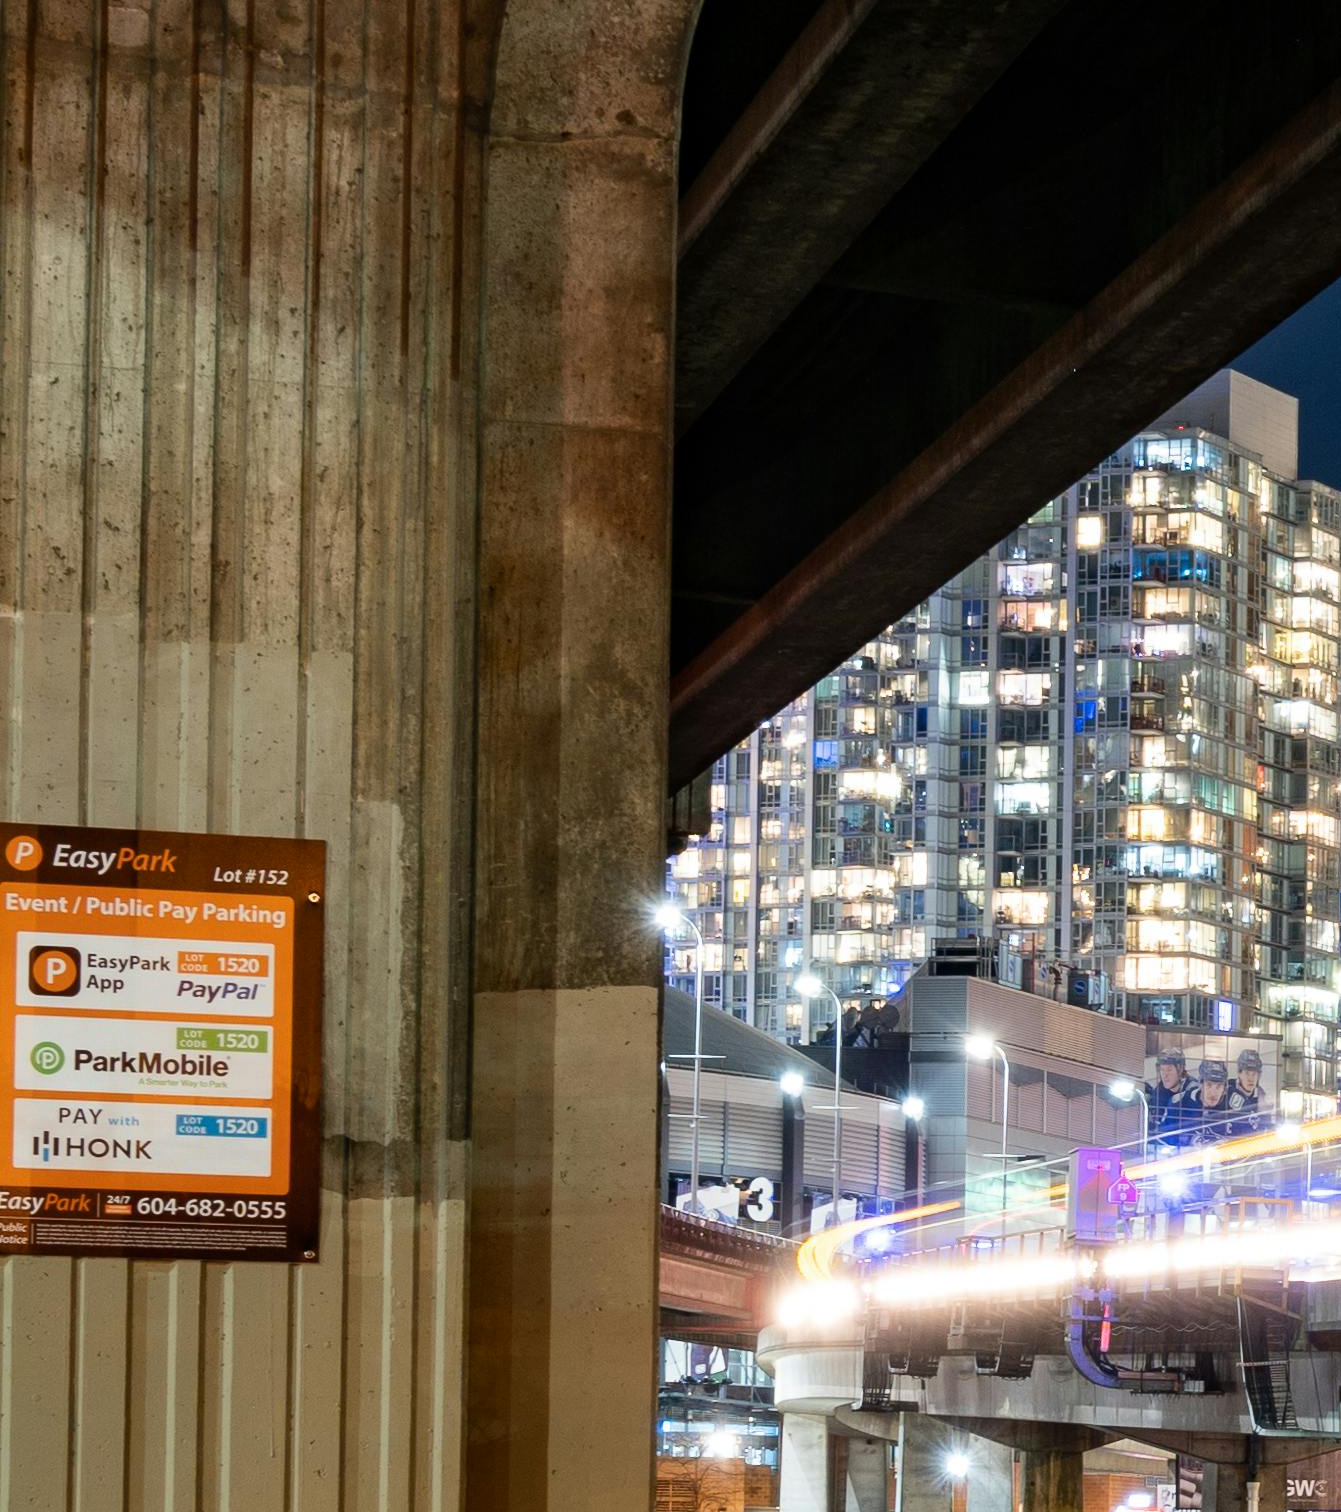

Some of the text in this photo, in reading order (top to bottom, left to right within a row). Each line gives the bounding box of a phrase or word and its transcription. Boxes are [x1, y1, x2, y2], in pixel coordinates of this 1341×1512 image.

[52, 843, 178, 875] EasyPark
[213, 866, 289, 885] Lot #152
[5, 892, 68, 913] Event
[86, 896, 154, 918] Public
[158, 900, 198, 924] Pay
[202, 902, 286, 929] Parking
[87, 953, 171, 973] EasyPark
[185, 953, 205, 962] LOT
[217, 957, 260, 973] 1520
[180, 963, 209, 973] CODE
[86, 974, 124, 993] App
[176, 980, 258, 1003] PayPal
[179, 1039, 208, 1048] CODE
[183, 1030, 203, 1038] LOT
[216, 1033, 259, 1049] 1520
[74, 1049, 229, 1077] ParkMobile
[59, 1107, 140, 1126] PAY with
[183, 1116, 203, 1124] LOT
[179, 1126, 207, 1134] CODE
[216, 1119, 258, 1134] 1520
[66, 1137, 152, 1160] HONK
[0, 1191, 91, 1215] EasyPark
[106, 1195, 131, 1204] 24/7
[137, 1197, 286, 1219] 604-682-0555
[747, 1176, 774, 1222] 3
